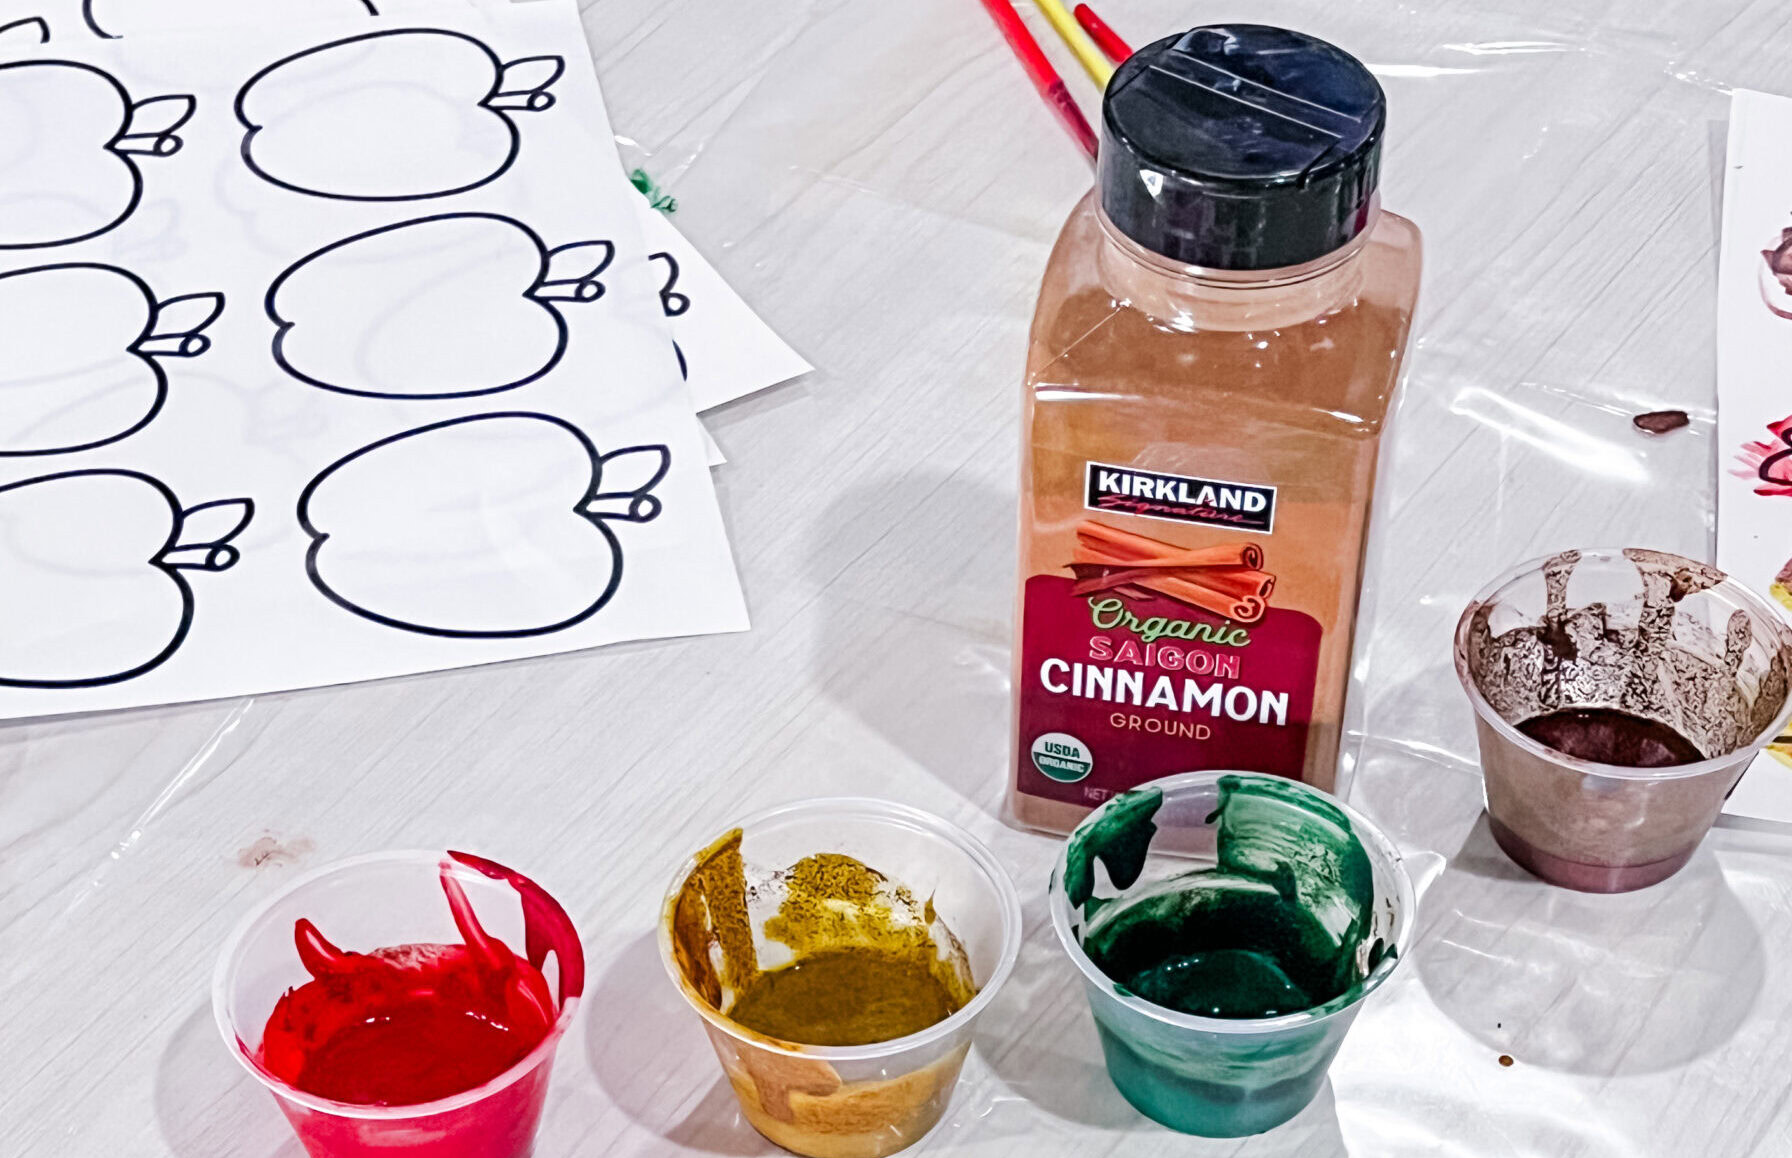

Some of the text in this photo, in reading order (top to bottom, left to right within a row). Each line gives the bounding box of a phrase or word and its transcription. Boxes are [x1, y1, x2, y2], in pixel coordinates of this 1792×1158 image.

[1098, 470, 1267, 513] KIRKLAND
[1087, 596, 1252, 648] Organic
[1088, 635, 1241, 680] SAIGON
[1039, 657, 1289, 727] CINNAMON
[1110, 712, 1211, 741] GROUND
[1038, 755, 1085, 773] ORGANIC
[1044, 741, 1081, 759] USDA
[1084, 786, 1108, 801] NET
